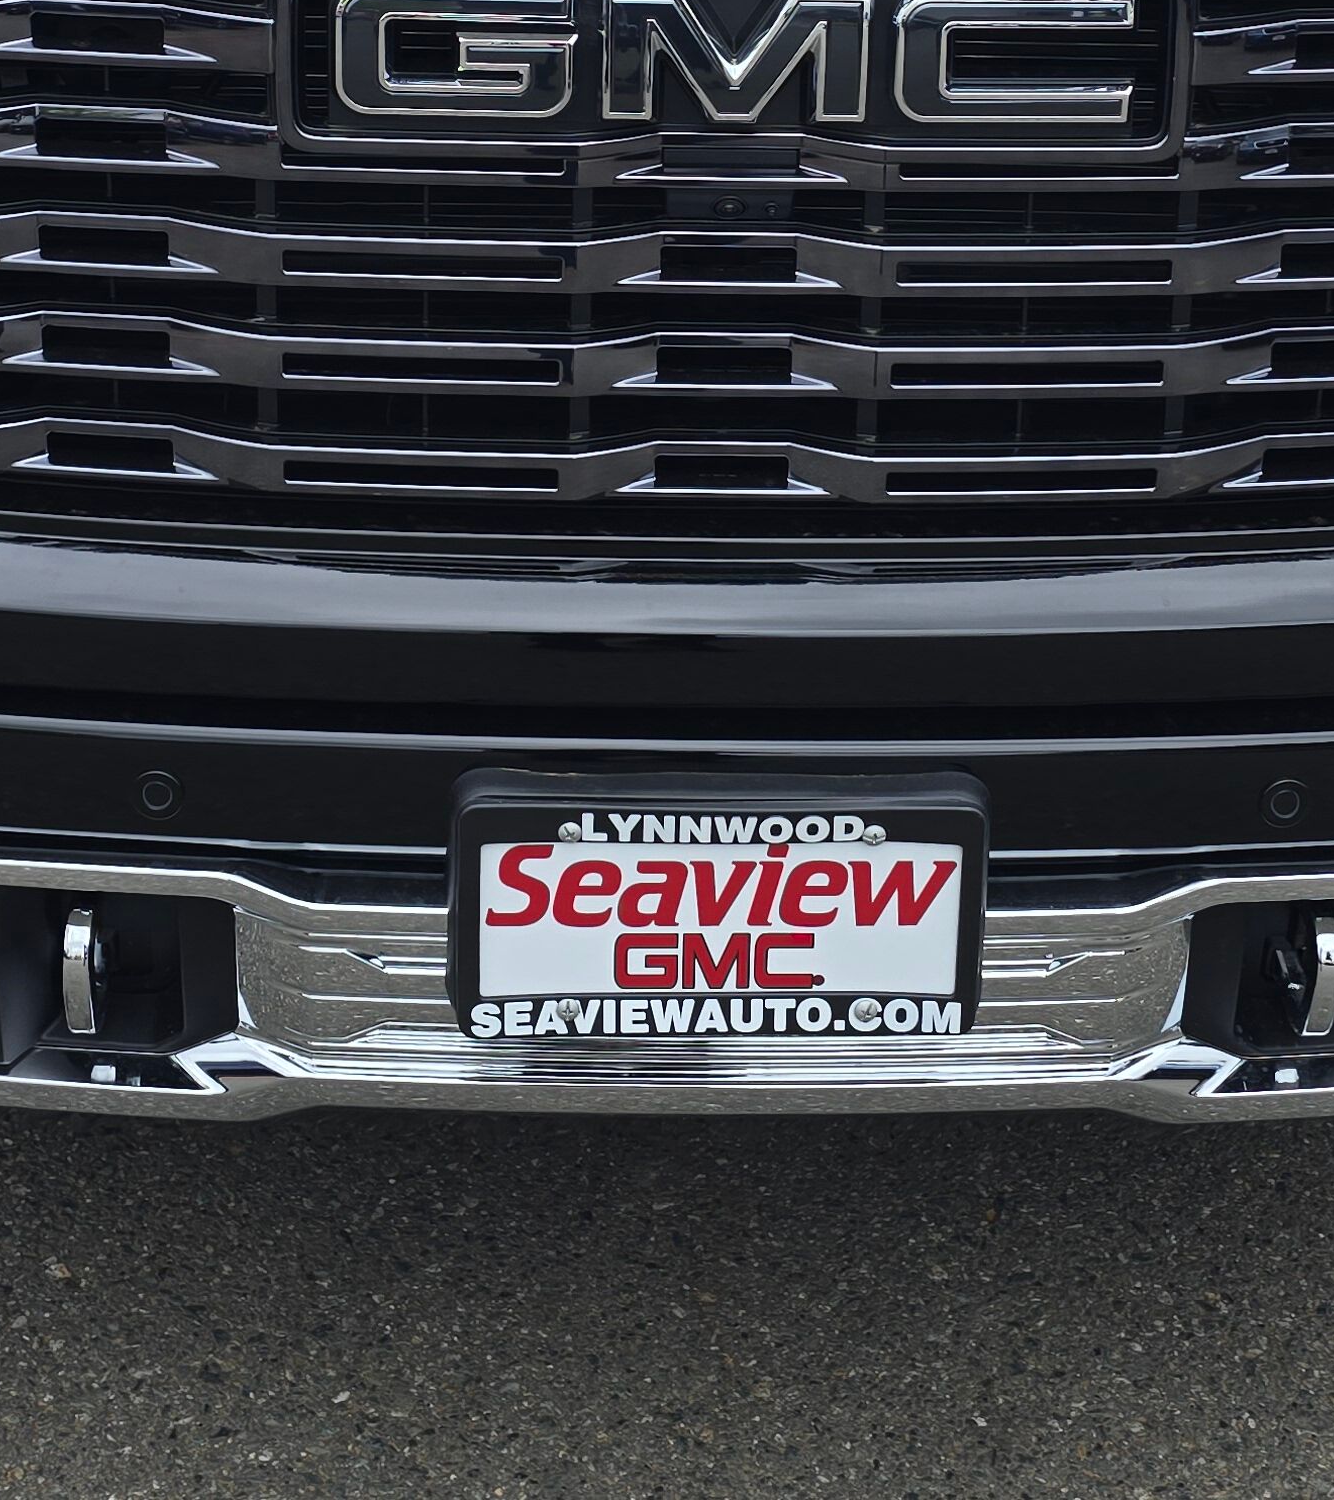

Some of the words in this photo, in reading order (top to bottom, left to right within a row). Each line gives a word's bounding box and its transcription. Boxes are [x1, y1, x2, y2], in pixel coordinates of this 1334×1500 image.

[581, 812, 865, 844] LYNNWOOD
[485, 843, 958, 928] Seaview
[613, 933, 825, 990] GMC
[470, 998, 962, 1038] SEAVIEWAUTO.COM
